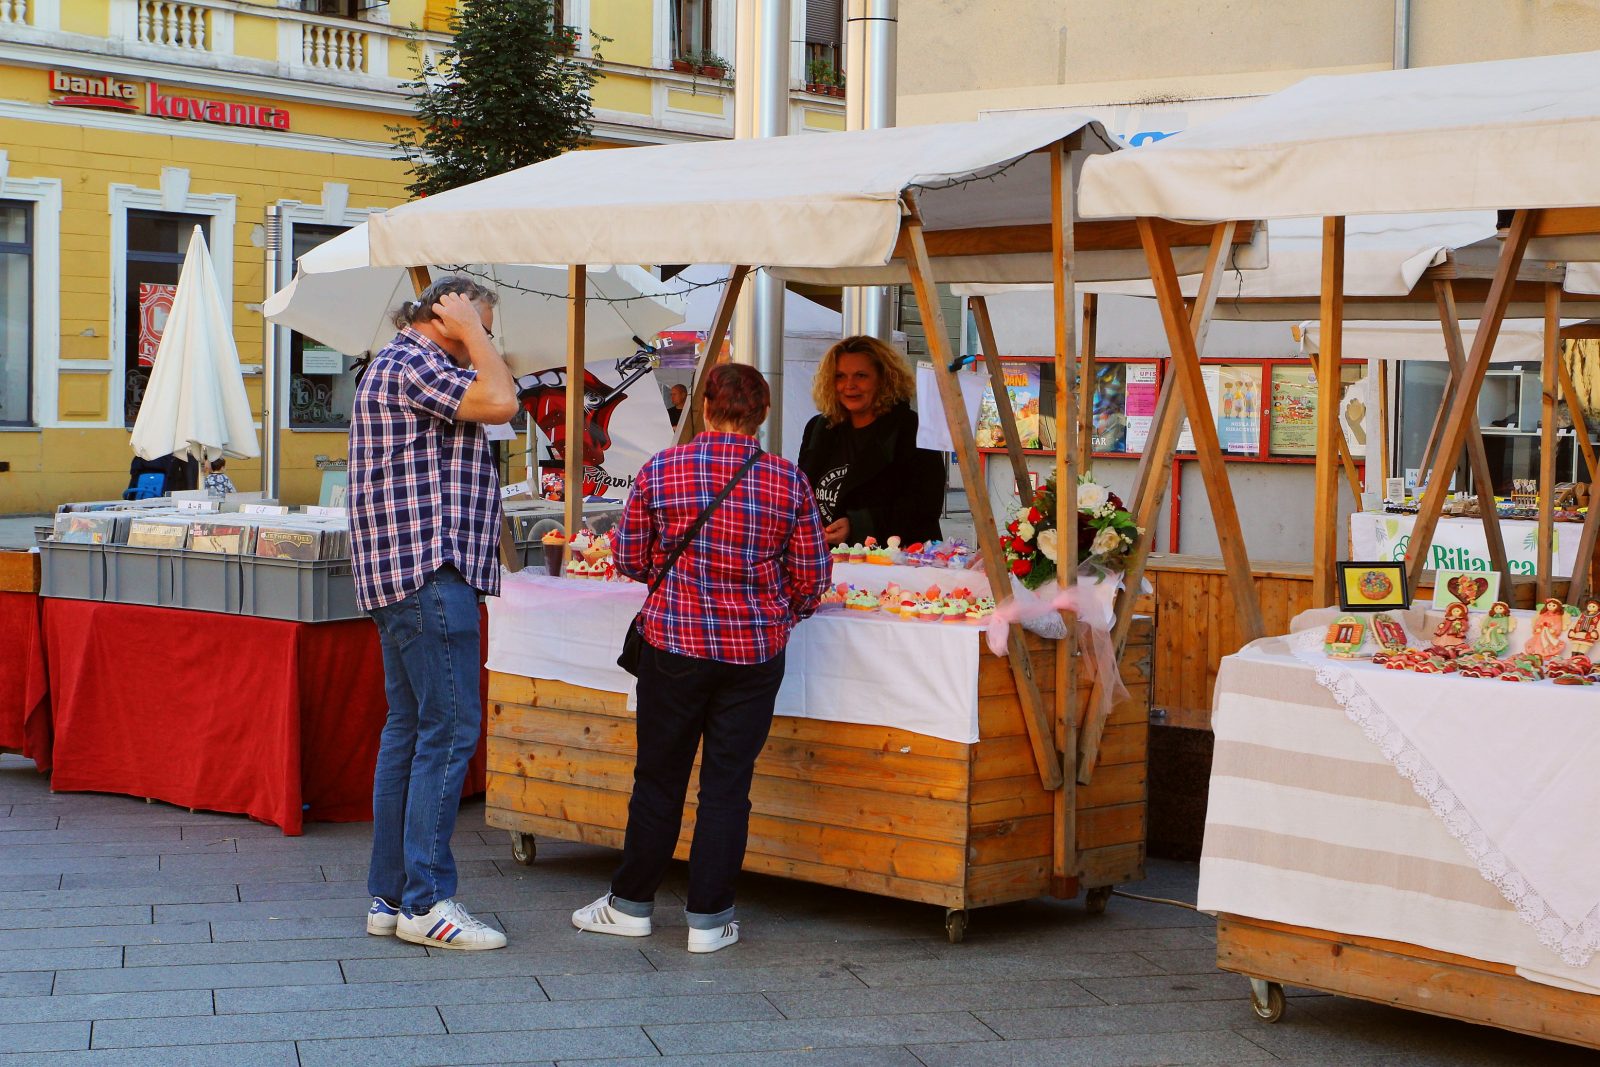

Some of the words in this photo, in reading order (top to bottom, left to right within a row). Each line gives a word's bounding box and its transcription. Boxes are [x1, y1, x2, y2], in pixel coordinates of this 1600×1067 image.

[50, 70, 139, 99] banka
[145, 82, 290, 130] kovanica
[1091, 437, 1107, 446] TAR
